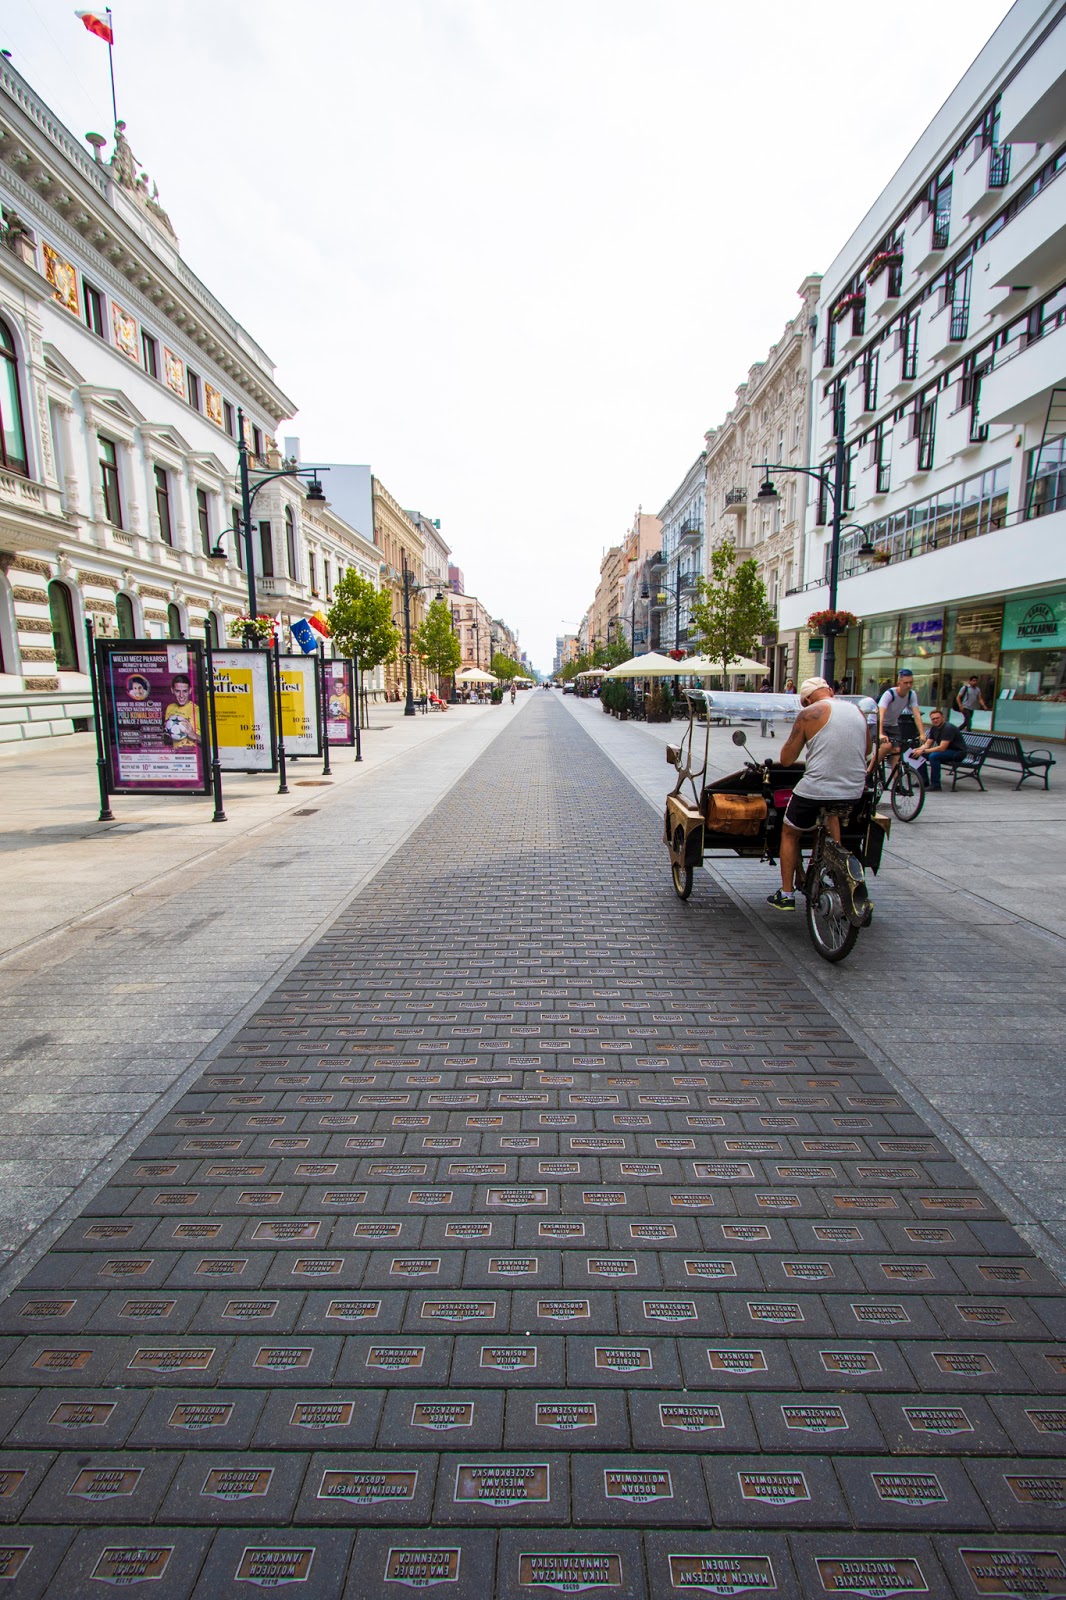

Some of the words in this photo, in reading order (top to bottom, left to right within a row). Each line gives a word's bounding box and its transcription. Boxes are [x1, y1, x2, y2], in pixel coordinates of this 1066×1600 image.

[227, 682, 248, 692] fest
[281, 682, 300, 691] fest
[472, 1468, 534, 1476] SZCZERKOWSKA
[610, 1474, 665, 1482] WOJTKOWIAK
[744, 1476, 800, 1484] WOJTKOWIAK
[879, 1478, 935, 1486] WOJTKOWIAK
[218, 1482, 254, 1490] RYSZARD
[328, 1485, 361, 1494] KINESIA
[366, 1486, 408, 1494] KAROLINA
[622, 1485, 656, 1493] BOGDAN
[755, 1486, 794, 1494] BARBARA
[478, 1488, 527, 1497] KATARZYNA
[912, 1488, 941, 1497] TOMEK
[108, 1552, 162, 1561] JANKOWSKI
[250, 1553, 303, 1562] JANKOWSKI
[399, 1553, 449, 1563] UCZENNICA
[531, 1558, 609, 1568] GIMNAZJALISTKA
[701, 1560, 740, 1570] STUDENT
[250, 1565, 295, 1574] WOJCIECH
[394, 1566, 426, 1575] GUBIEC
[430, 1566, 449, 1575] EWA
[840, 1563, 896, 1573] NAUCZYCIEL
[532, 1570, 578, 1580] KLIMCZAK
[583, 1570, 608, 1580] LILKA
[731, 1573, 768, 1583] MARCIN
[833, 1576, 876, 1586] MISZKIEL
[878, 1576, 912, 1586] MACIEJ
